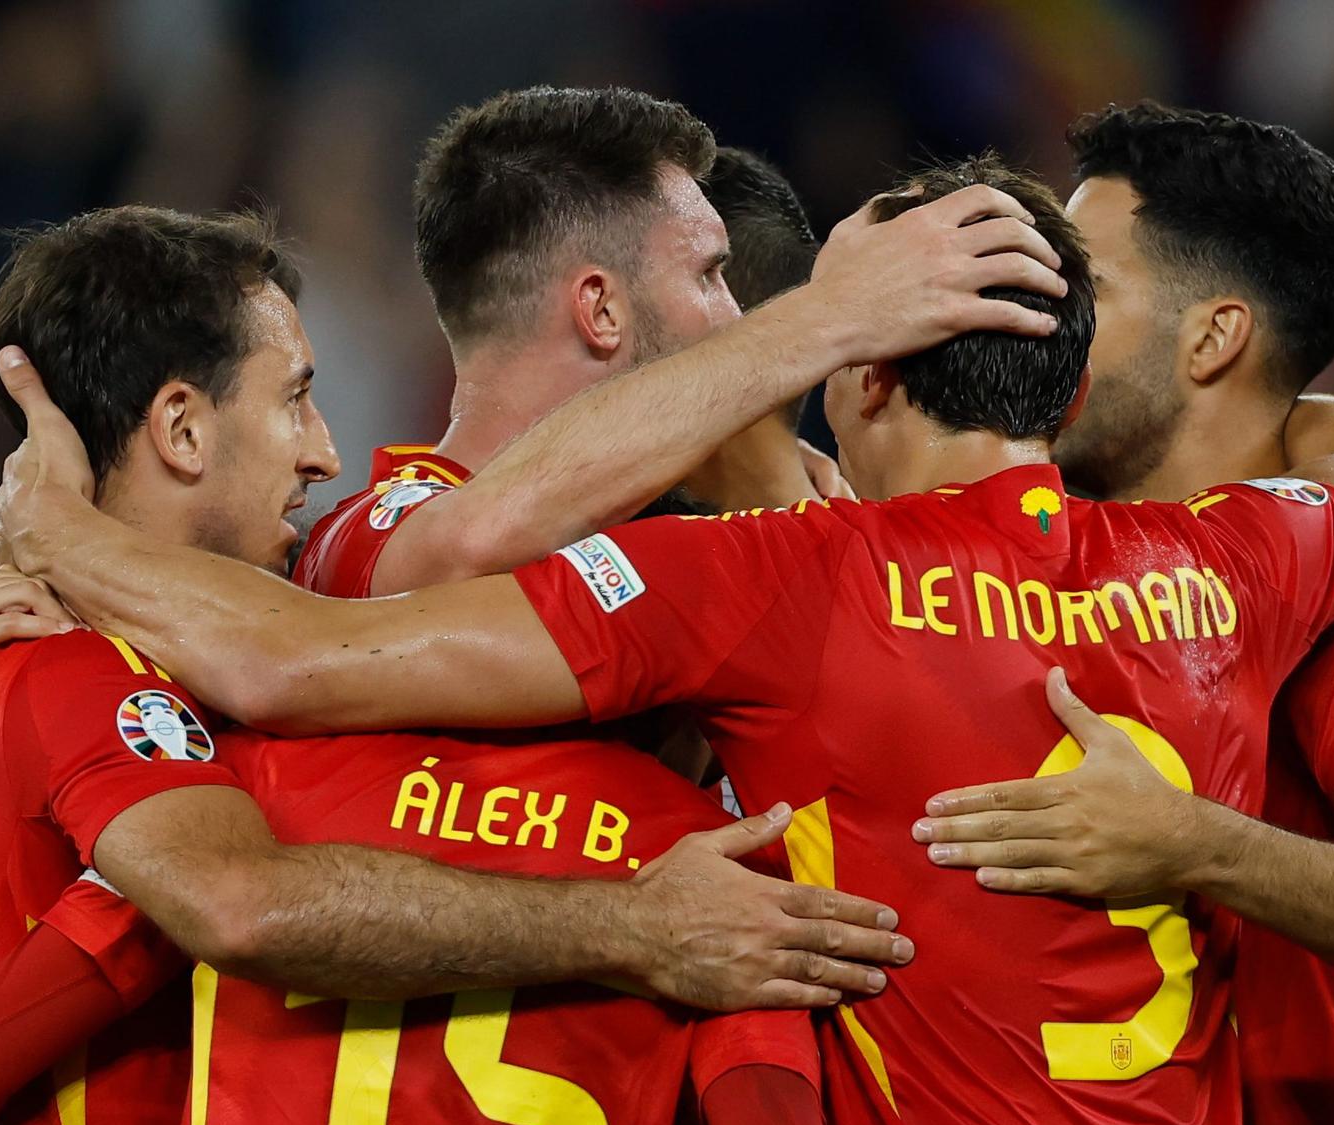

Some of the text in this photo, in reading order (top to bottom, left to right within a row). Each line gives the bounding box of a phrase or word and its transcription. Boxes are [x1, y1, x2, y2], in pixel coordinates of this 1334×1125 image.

[886, 560, 1237, 646] LE NORMAND
[390, 756, 640, 870] ÁLEX B.
